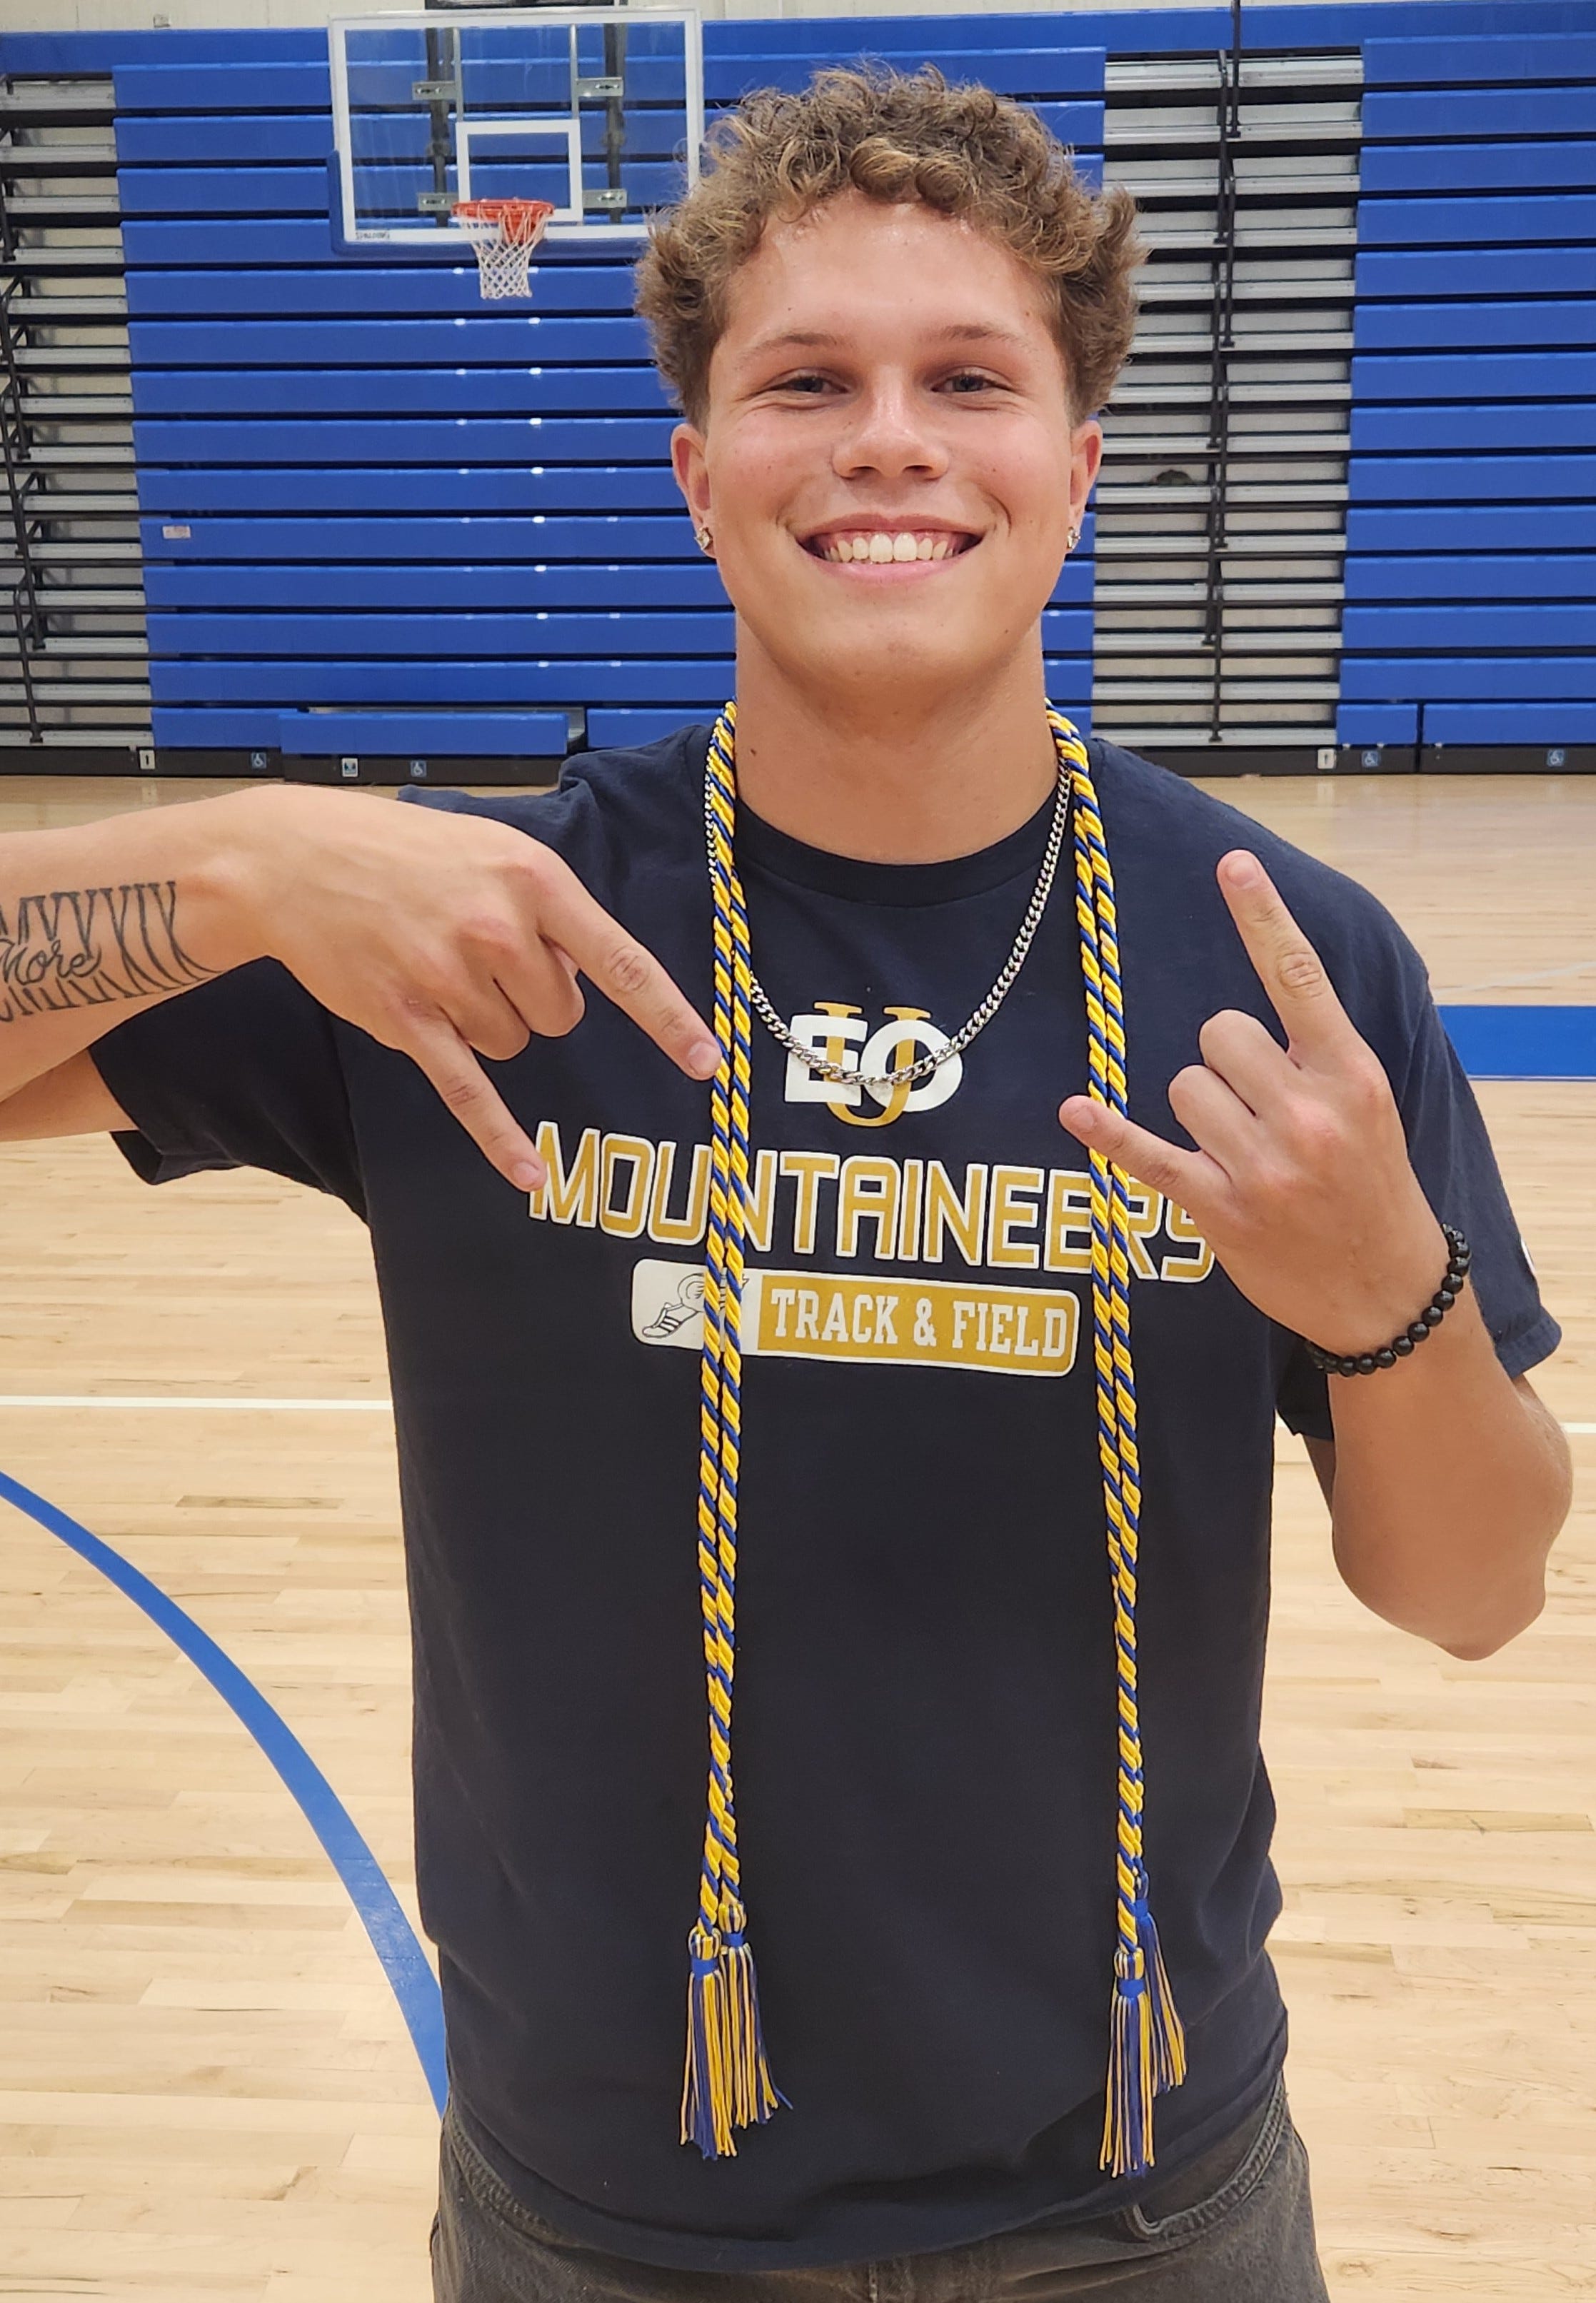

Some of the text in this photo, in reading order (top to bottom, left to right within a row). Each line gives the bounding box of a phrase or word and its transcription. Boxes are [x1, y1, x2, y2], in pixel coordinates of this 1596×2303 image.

[529, 1121, 1215, 1283] MOUNTAINEERS
[771, 1288, 1068, 1358] TRACK & FIELD
